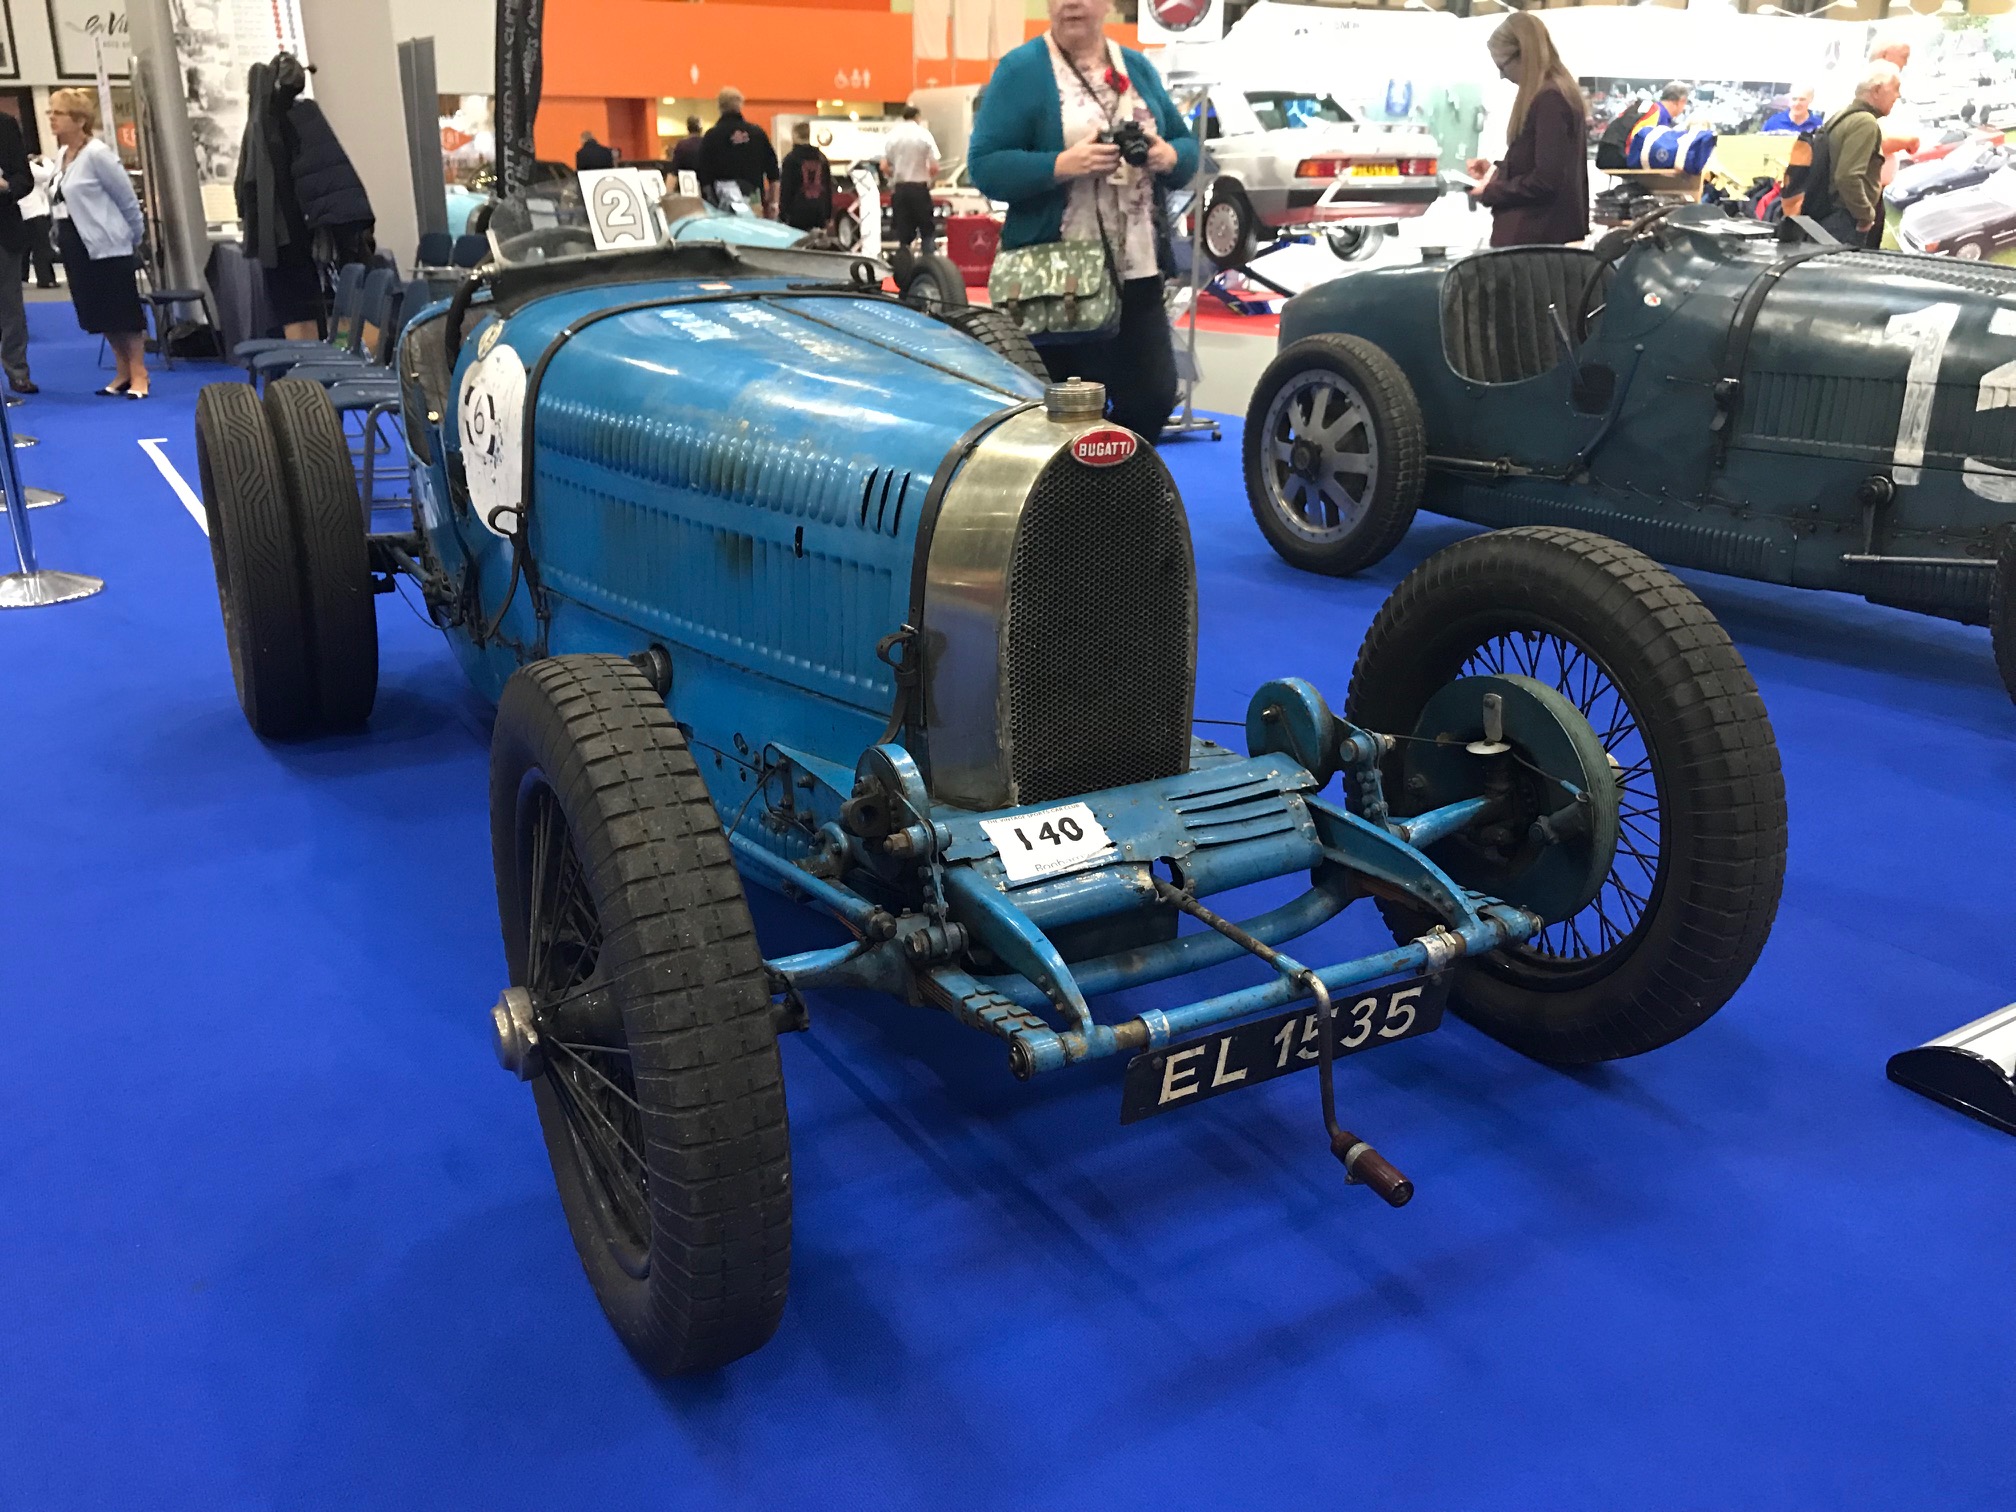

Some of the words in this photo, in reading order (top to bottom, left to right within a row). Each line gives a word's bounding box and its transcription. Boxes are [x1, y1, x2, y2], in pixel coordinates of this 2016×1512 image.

[601, 188, 637, 228] 2
[473, 394, 485, 435] 6
[1079, 441, 1131, 457] BUGATTI
[1000, 815, 1026, 823] VINTAGE
[1026, 810, 1051, 819] SPORTS
[1064, 803, 1081, 811] CLUB
[1014, 817, 1084, 850] 140
[1034, 855, 1086, 872] Bonham
[1158, 1036, 1248, 1106] EL
[1273, 985, 1423, 1068] 1535
